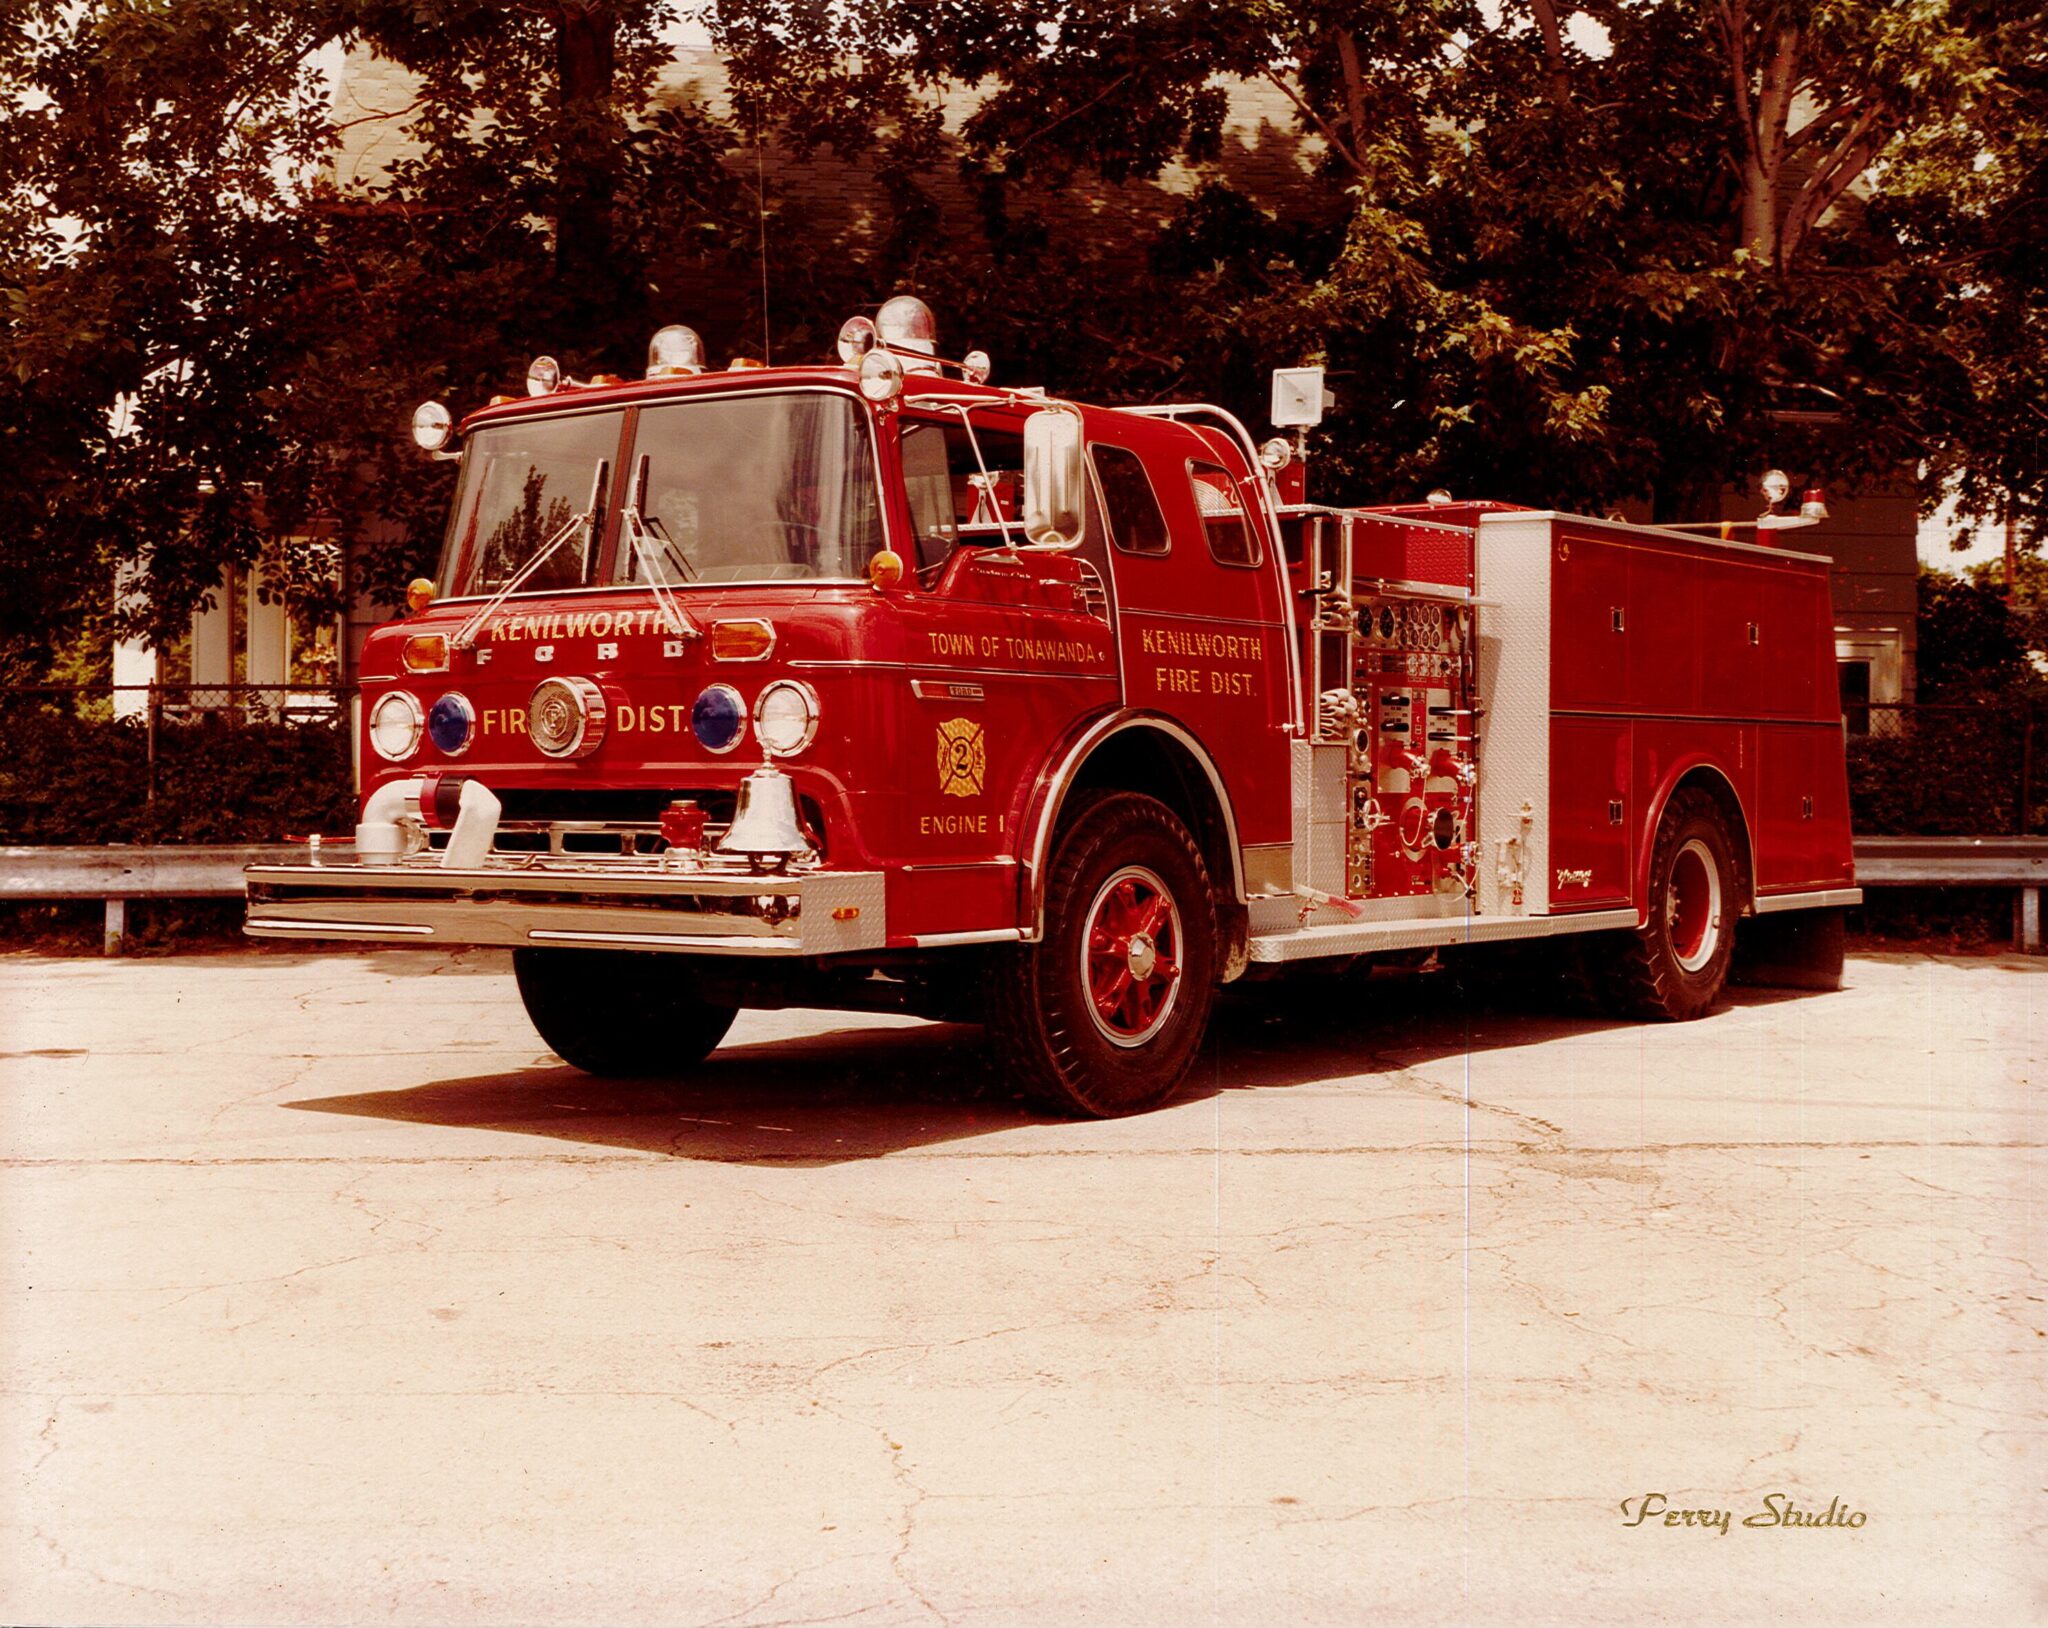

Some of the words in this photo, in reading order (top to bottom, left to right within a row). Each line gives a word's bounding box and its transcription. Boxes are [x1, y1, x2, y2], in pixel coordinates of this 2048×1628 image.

[490, 610, 671, 641] KENILWORTH
[476, 640, 685, 665] FORD
[928, 632, 975, 656] TOWN
[981, 636, 999, 658] OF
[1142, 629, 1262, 661] KENILWORTH
[1156, 667, 1201, 693] FIRE
[1211, 671, 1258, 697] DIST.
[483, 708, 527, 735] FIR
[617, 705, 690, 733] DIST.
[954, 743, 969, 771] 2
[920, 815, 988, 835] ENGINE
[998, 814, 1004, 833] 1
